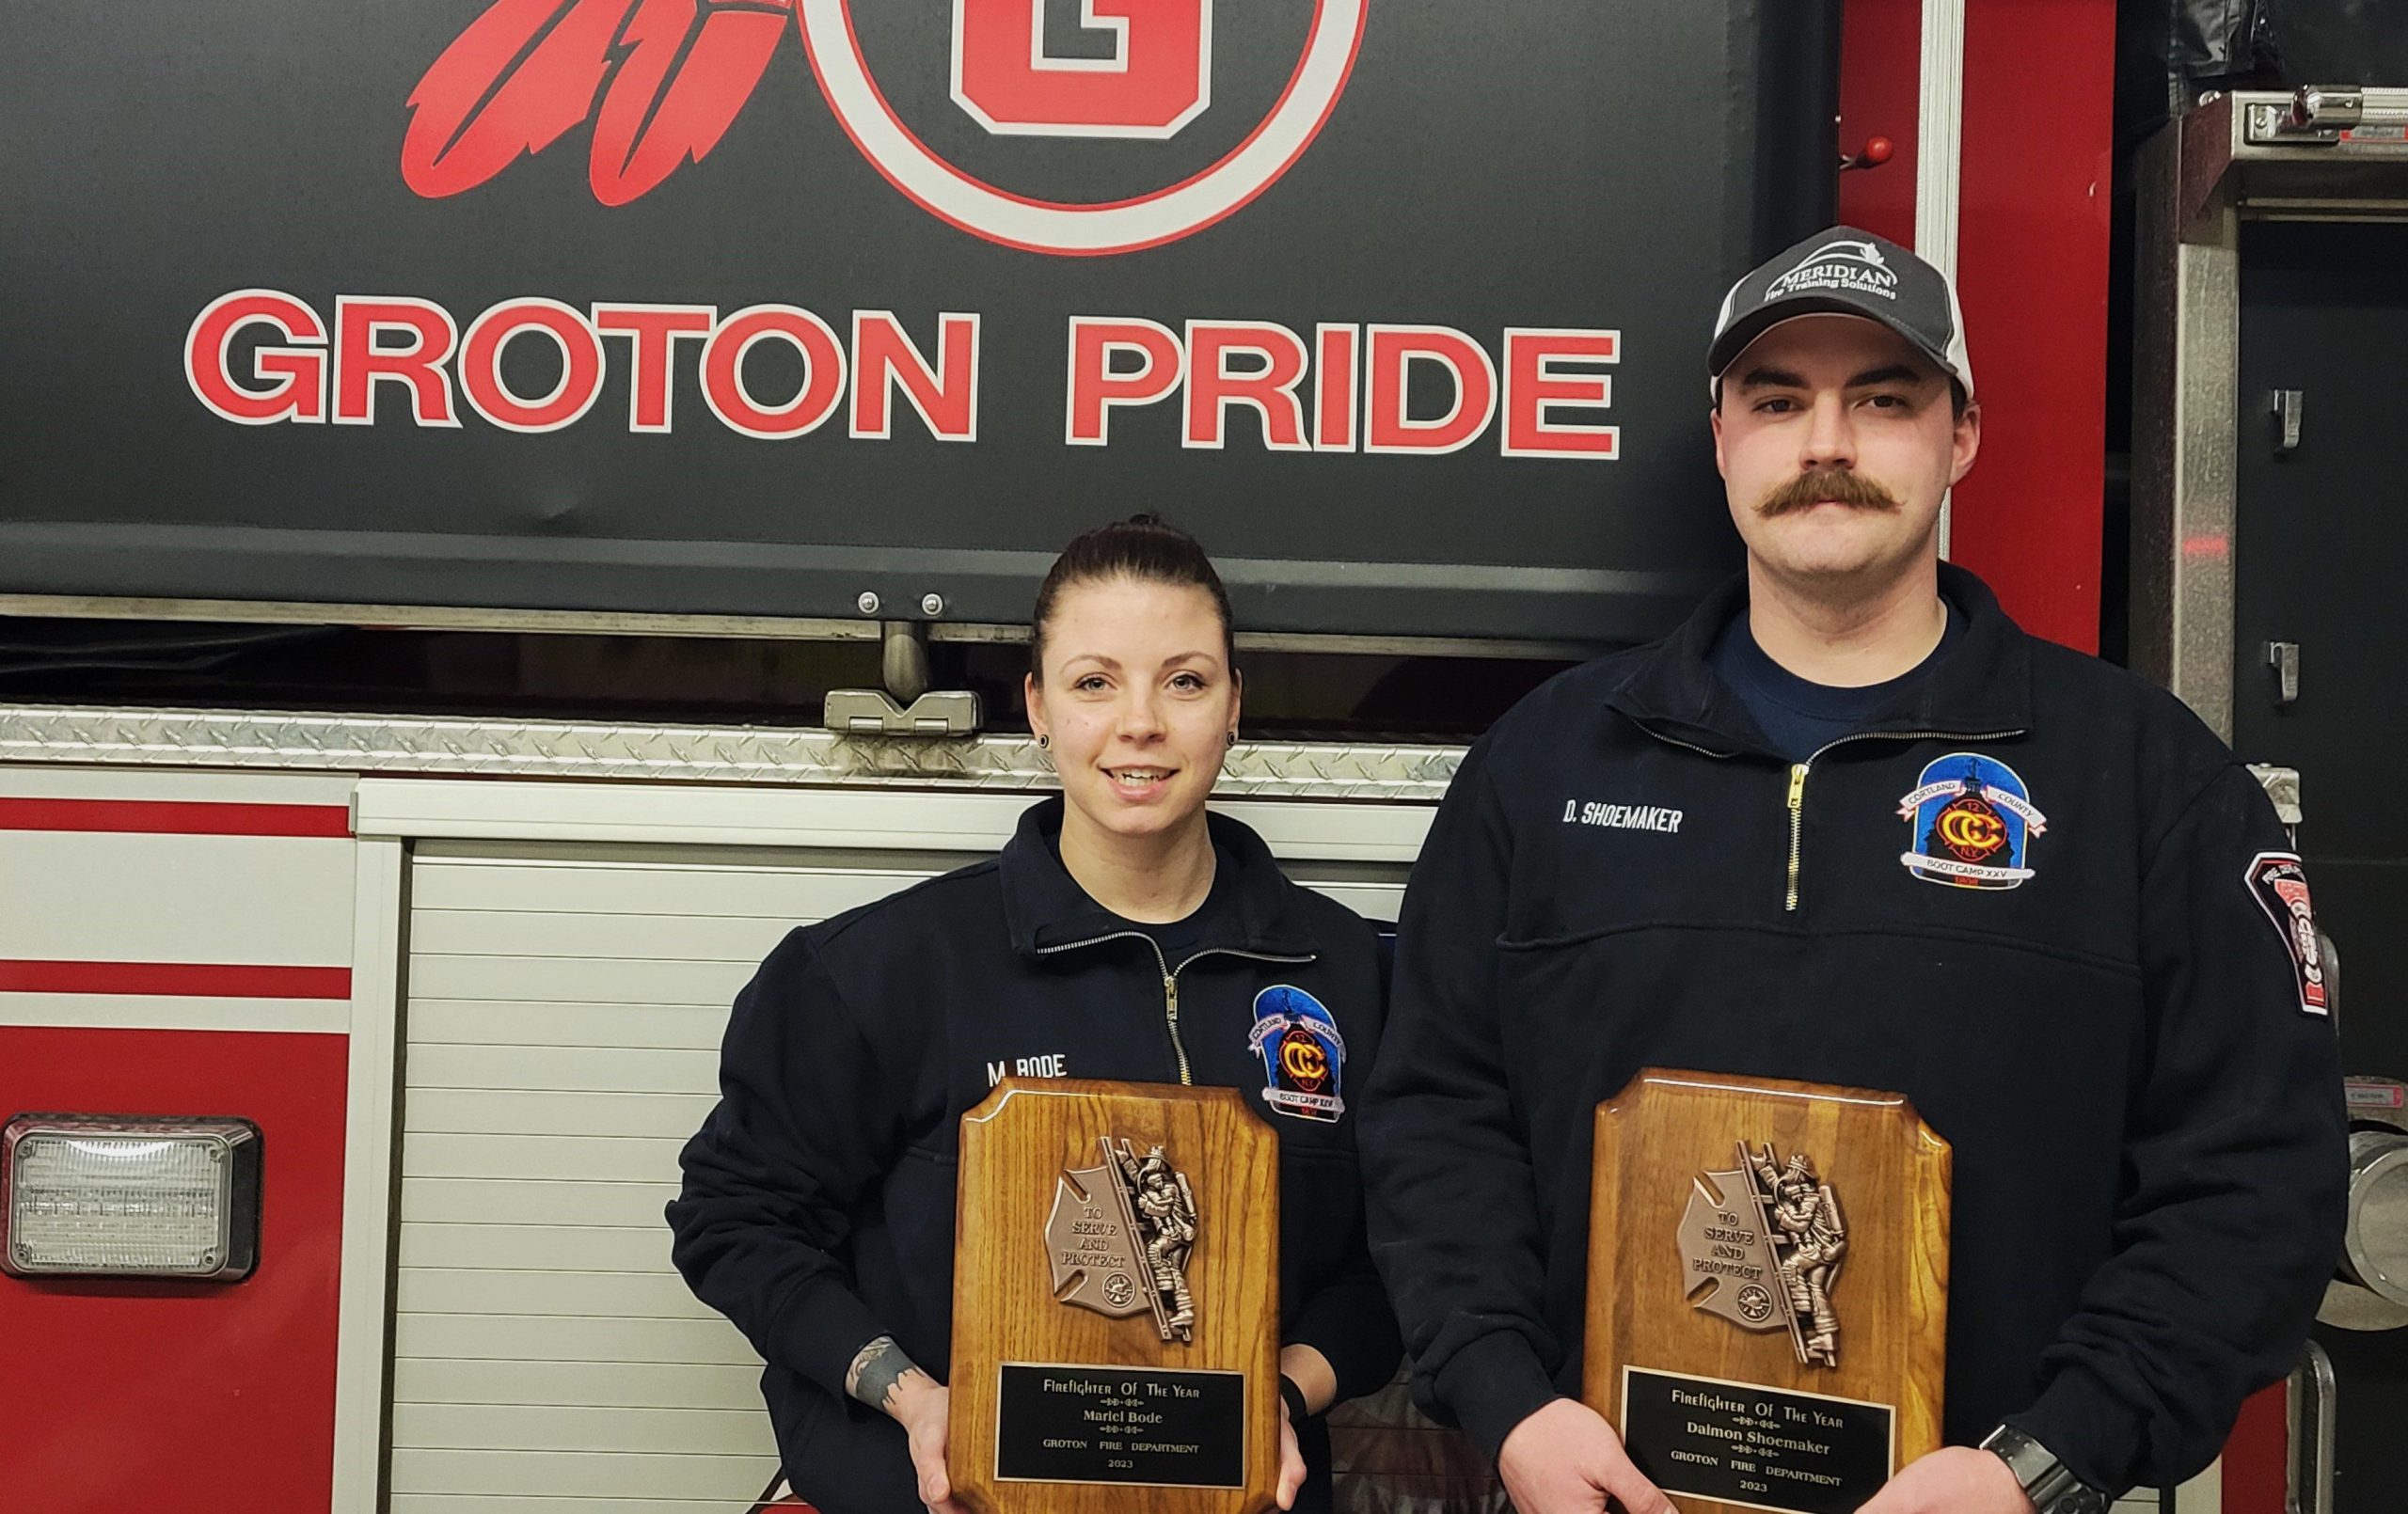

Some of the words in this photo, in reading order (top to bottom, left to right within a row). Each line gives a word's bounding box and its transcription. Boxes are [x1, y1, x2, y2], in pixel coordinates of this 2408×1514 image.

[1781, 264, 1892, 287] MERIDIAN
[1787, 276, 1841, 293] Training
[1841, 277, 1896, 301] Solutions
[183, 288, 981, 442] GROTON
[1065, 315, 1621, 460] PRIDE
[1908, 781, 1956, 805] CORTLAND
[1997, 793, 2035, 817] COUNTY
[1966, 802, 1980, 812] 12
[1562, 799, 1577, 823] D.
[1581, 801, 1683, 833] SHOEMAKER
[1926, 859, 1955, 872] BOOT
[1956, 864, 1984, 875] CAMP
[1986, 869, 2008, 878] XXV
[1083, 1206, 1103, 1220] TO
[1719, 1211, 1738, 1226] TO
[1071, 1222, 1117, 1237] SERVE
[1704, 1226, 1754, 1246] SERVE
[1079, 1238, 1109, 1252] AND
[1711, 1245, 1745, 1261] AND
[1061, 1252, 1125, 1269] PROTECT
[1693, 1258, 1762, 1280] PROTECT
[1120, 1381, 1137, 1396] Of
[1128, 1411, 1163, 1424] Bode
[1755, 1402, 1773, 1417] Of
[1042, 1439, 1087, 1449] GROTON
[1099, 1441, 1122, 1451] FIRE
[1131, 1443, 1199, 1454] DEPARTMENT
[1746, 1431, 1830, 1456] Shoemaker
[1108, 1459, 1133, 1469] 2023
[1671, 1450, 1719, 1467] GROTON
[1731, 1459, 1756, 1474] FIRE
[1766, 1465, 1843, 1488] DEPARTMENT
[1739, 1479, 1768, 1493] 2023
